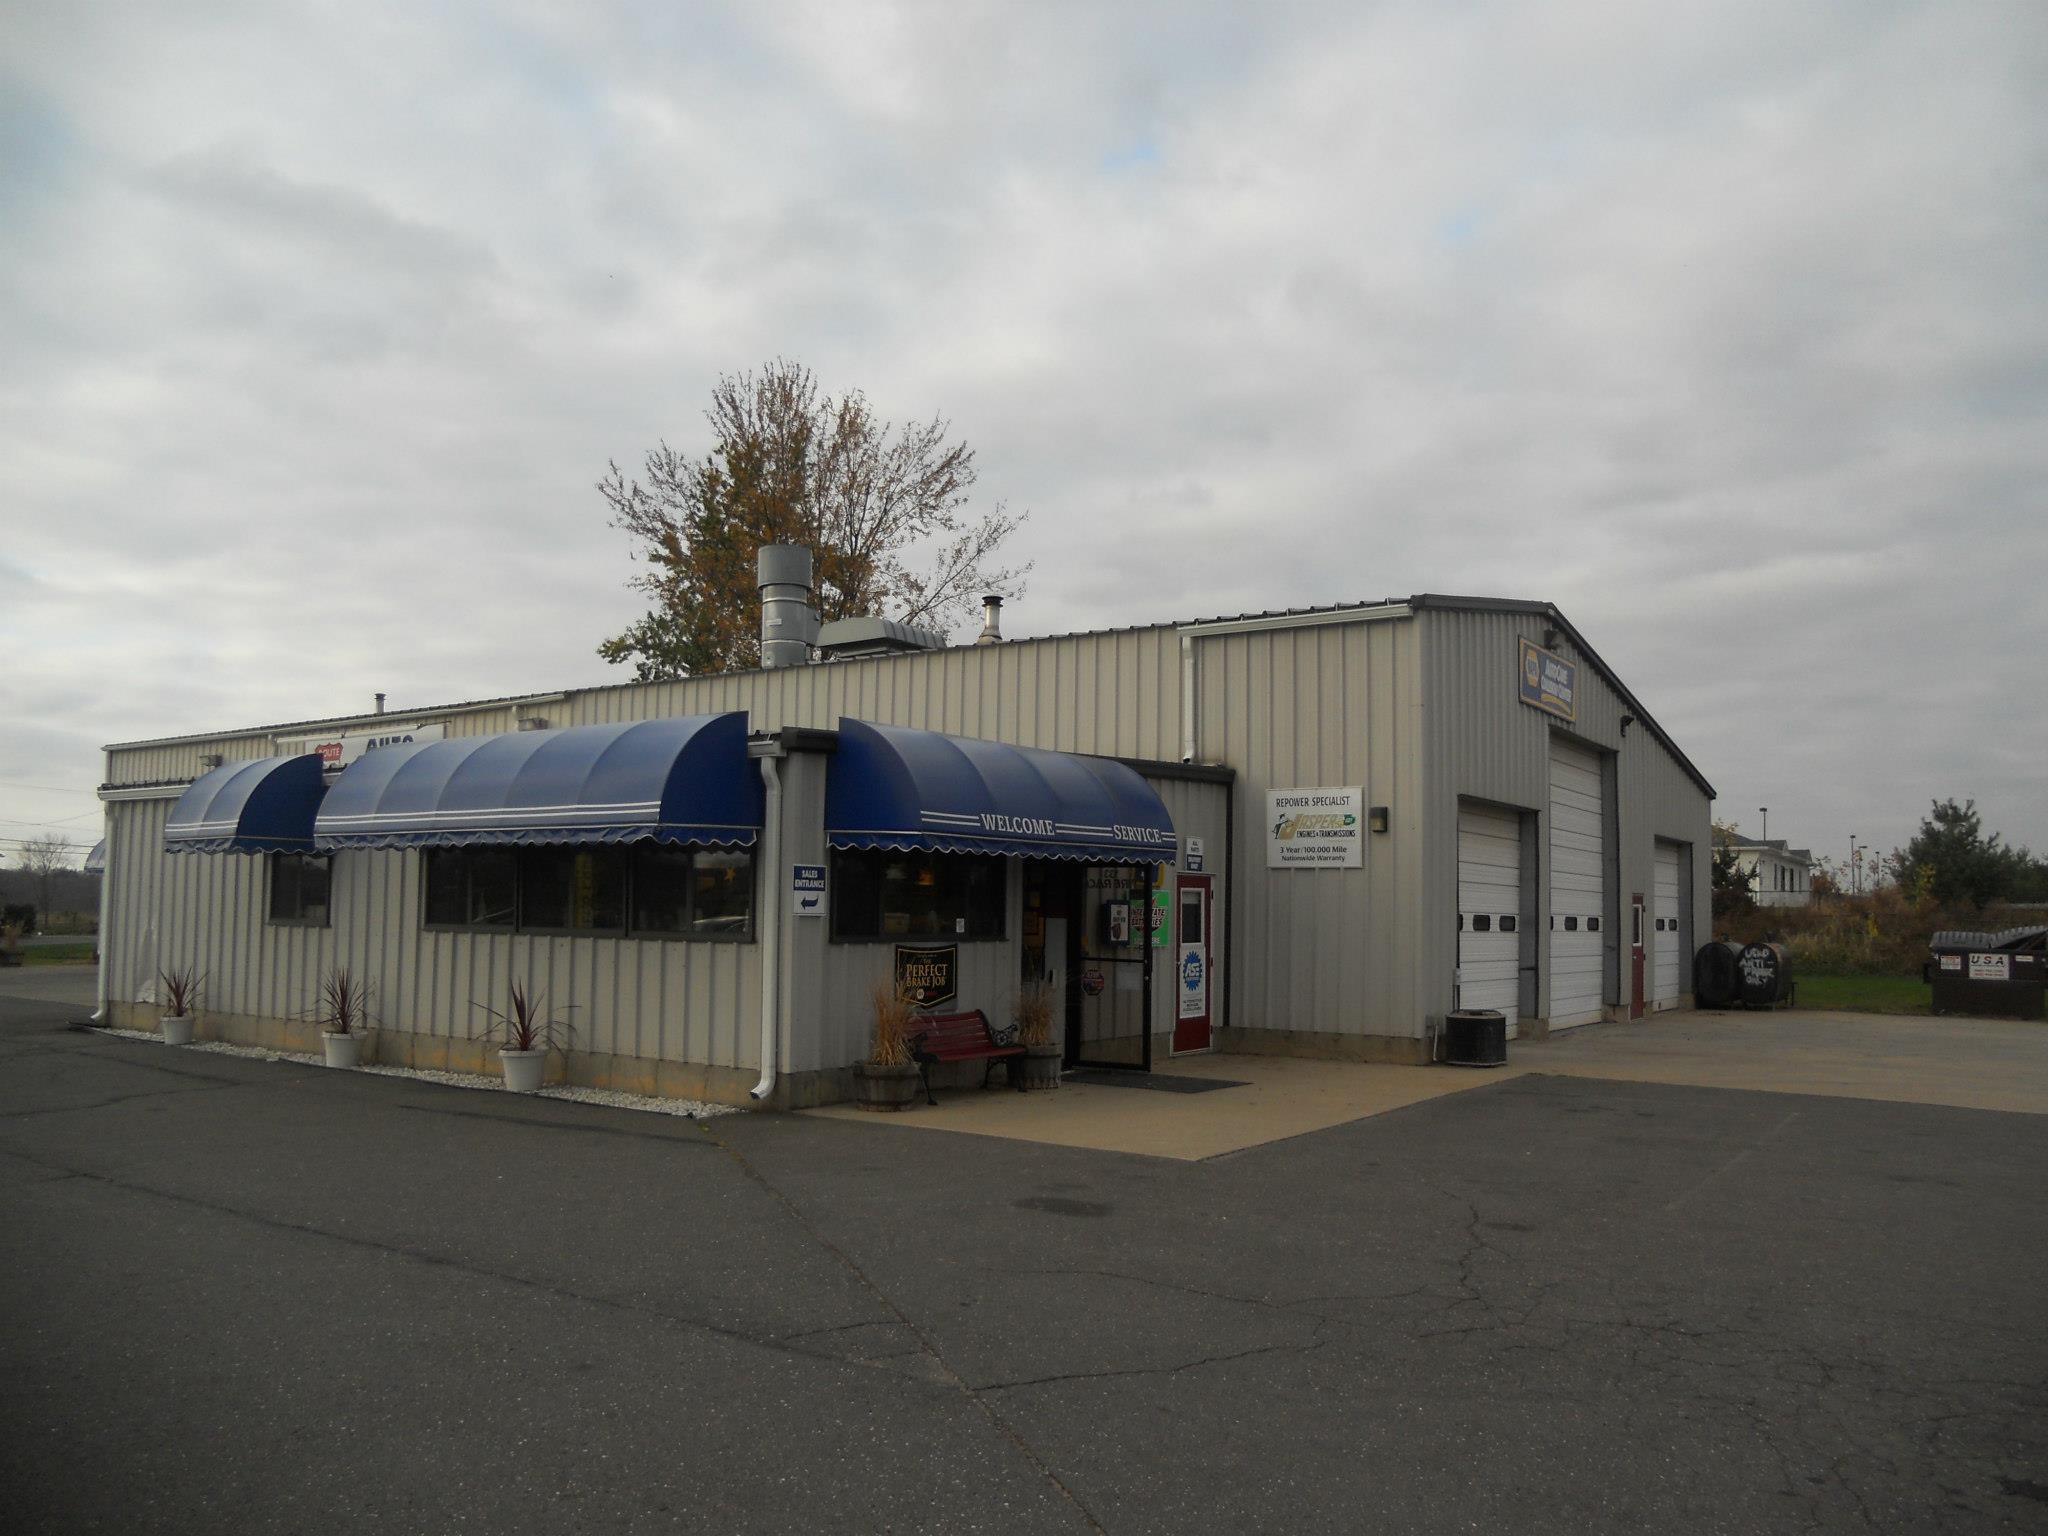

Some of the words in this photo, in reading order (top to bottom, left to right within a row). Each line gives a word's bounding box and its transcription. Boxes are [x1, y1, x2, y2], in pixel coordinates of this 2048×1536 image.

[1276, 798, 1308, 808] REPOWER
[1312, 796, 1350, 806] SPECIALIST
[981, 813, 1055, 836] WELCOME
[1113, 824, 1161, 843] SERVICE
[1317, 855, 1345, 863] Warranty
[801, 870, 818, 878] SALES
[795, 879, 825, 888] ENTRANCE
[906, 963, 948, 977] PERFECT
[906, 976, 931, 987] BRAKE
[932, 976, 946, 988] JOB
